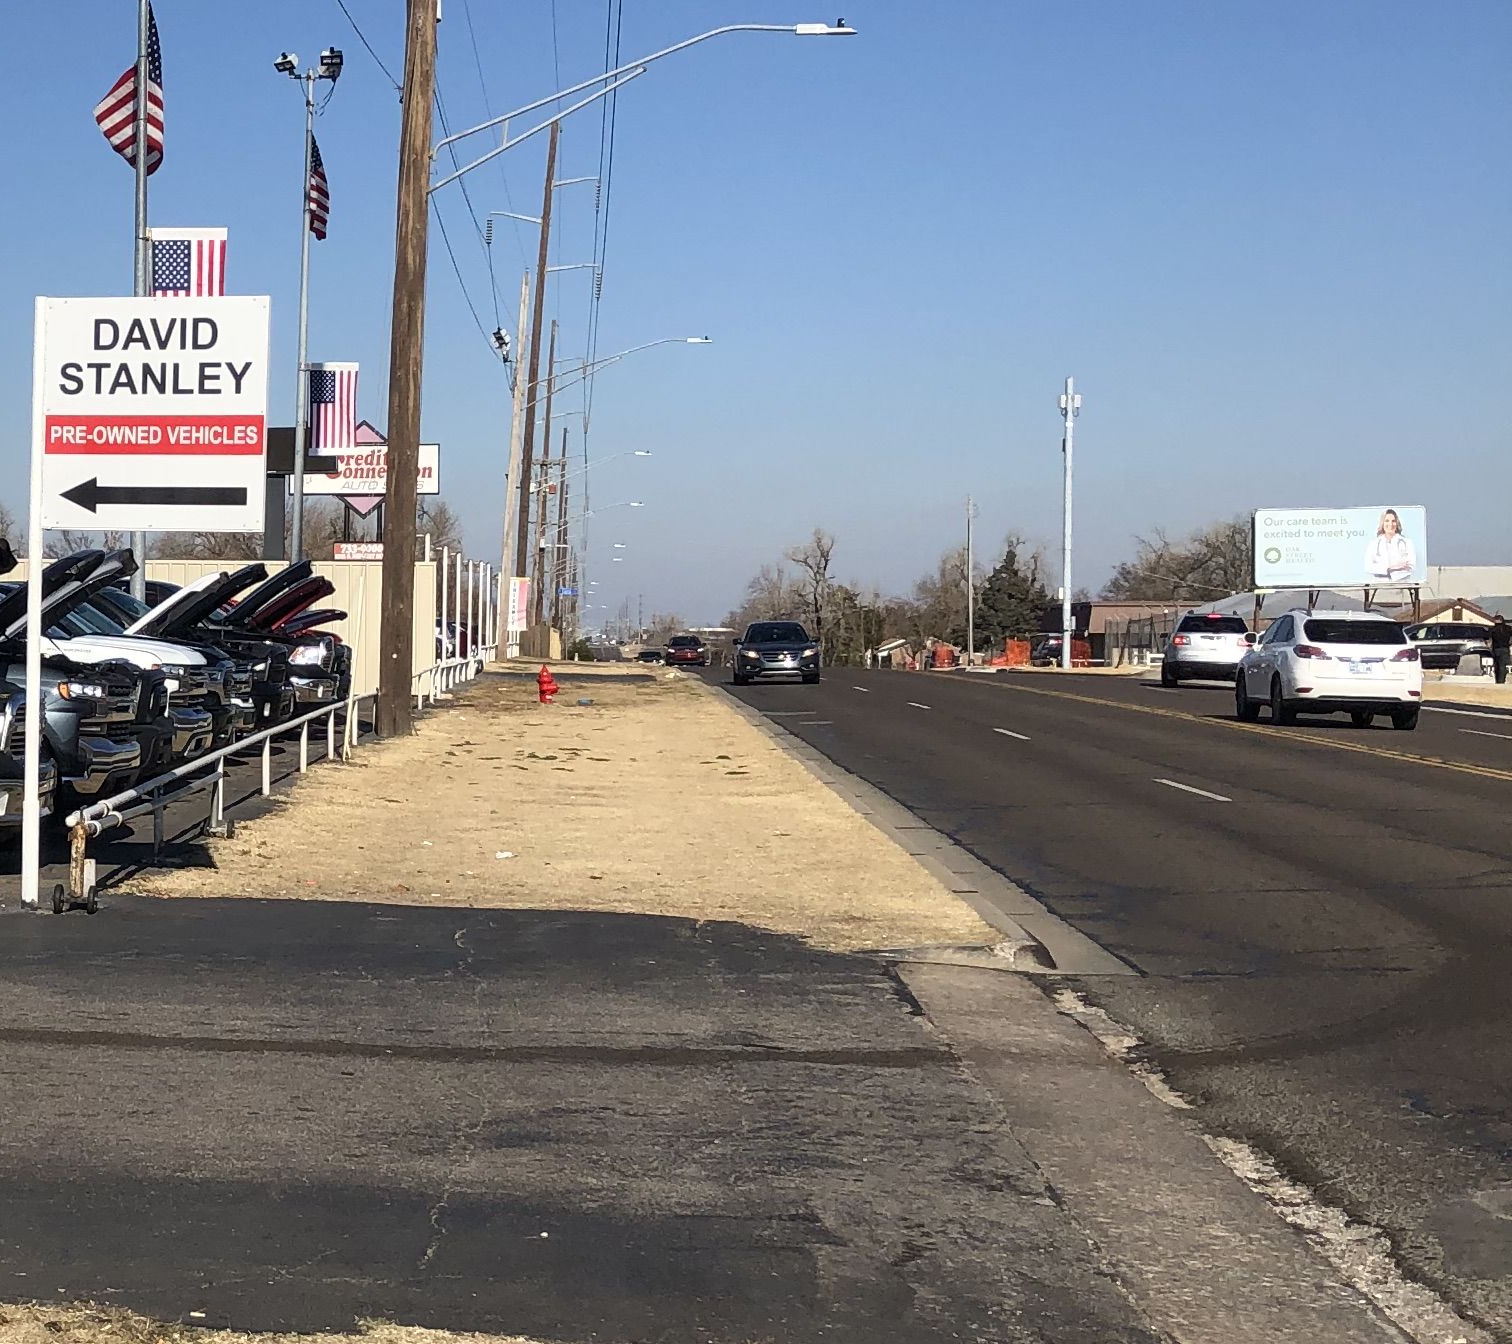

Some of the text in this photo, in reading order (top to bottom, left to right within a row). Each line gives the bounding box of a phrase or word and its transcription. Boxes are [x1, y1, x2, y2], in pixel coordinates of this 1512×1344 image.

[94, 317, 218, 351] DAVID
[59, 362, 252, 395] STANLEY
[50, 425, 258, 445] PRE-OWNED VEHICLES
[342, 481, 378, 490] AUTO
[1264, 516, 1348, 526] Our care team is
[1263, 529, 1301, 539] excited
[1304, 529, 1315, 538] to
[1317, 529, 1344, 537] meet
